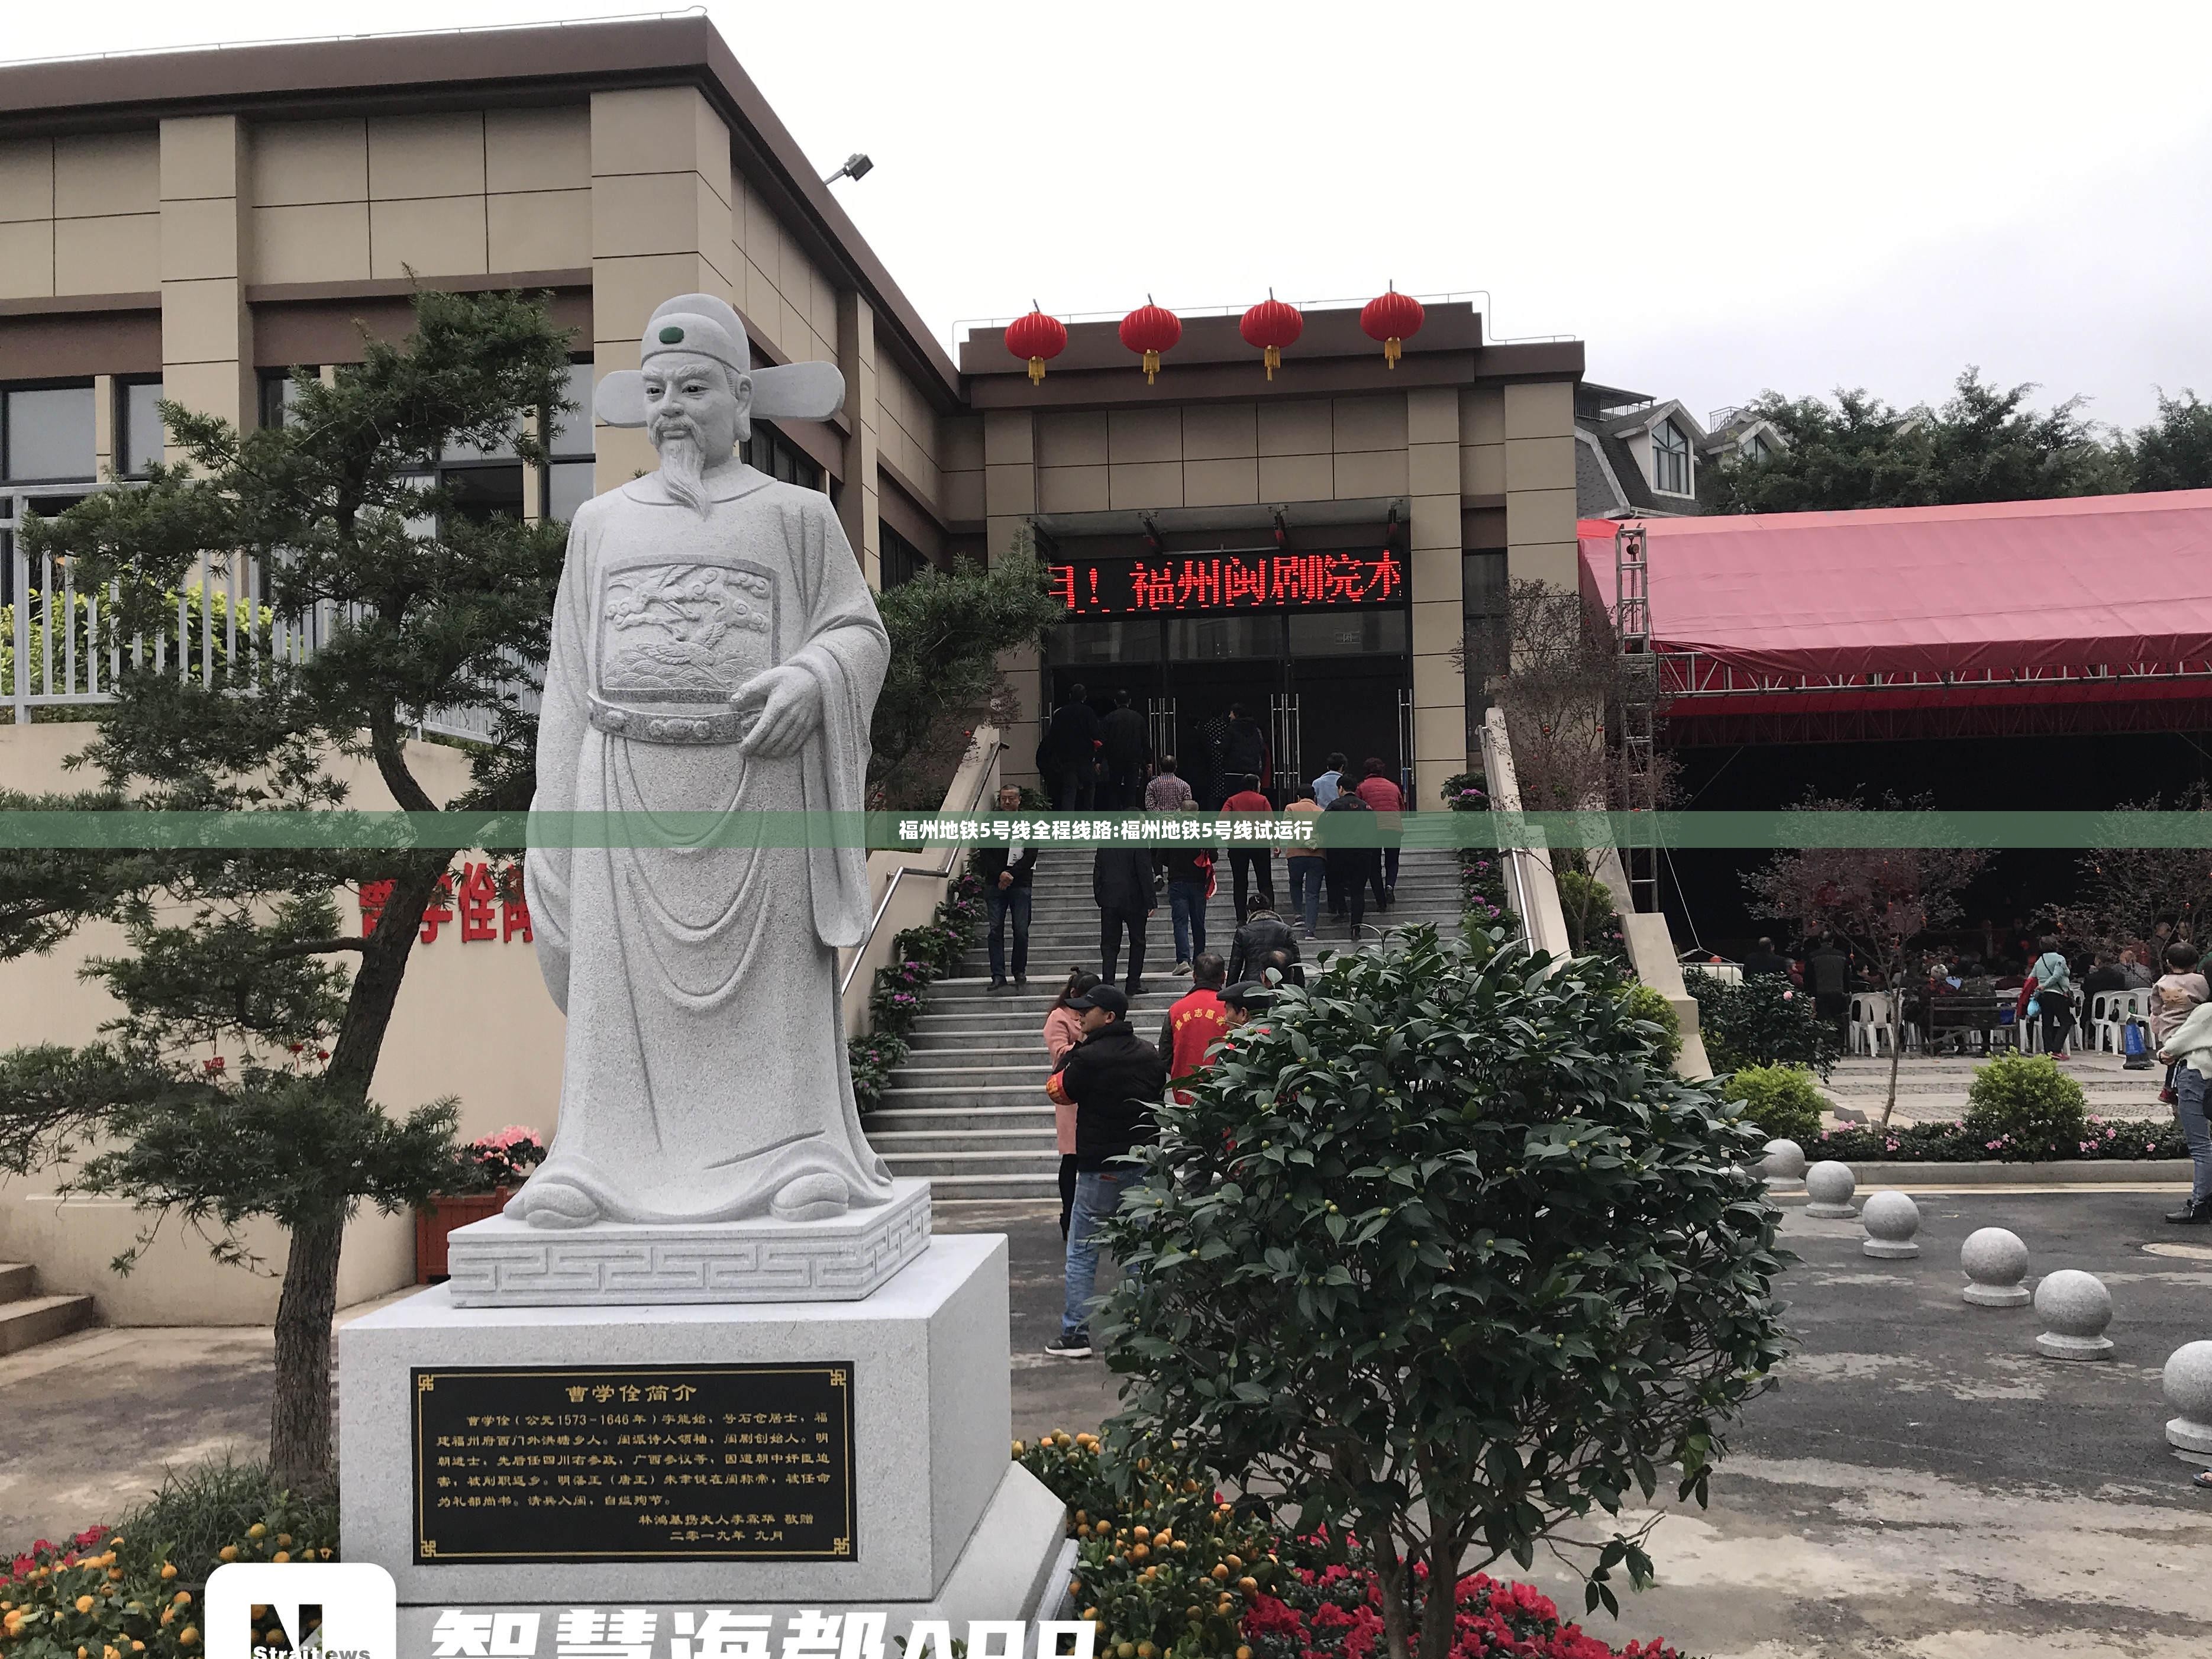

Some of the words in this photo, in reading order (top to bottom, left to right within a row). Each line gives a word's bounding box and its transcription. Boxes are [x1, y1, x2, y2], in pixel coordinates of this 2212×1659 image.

[564, 1384, 697, 1402] 曹学佺简介
